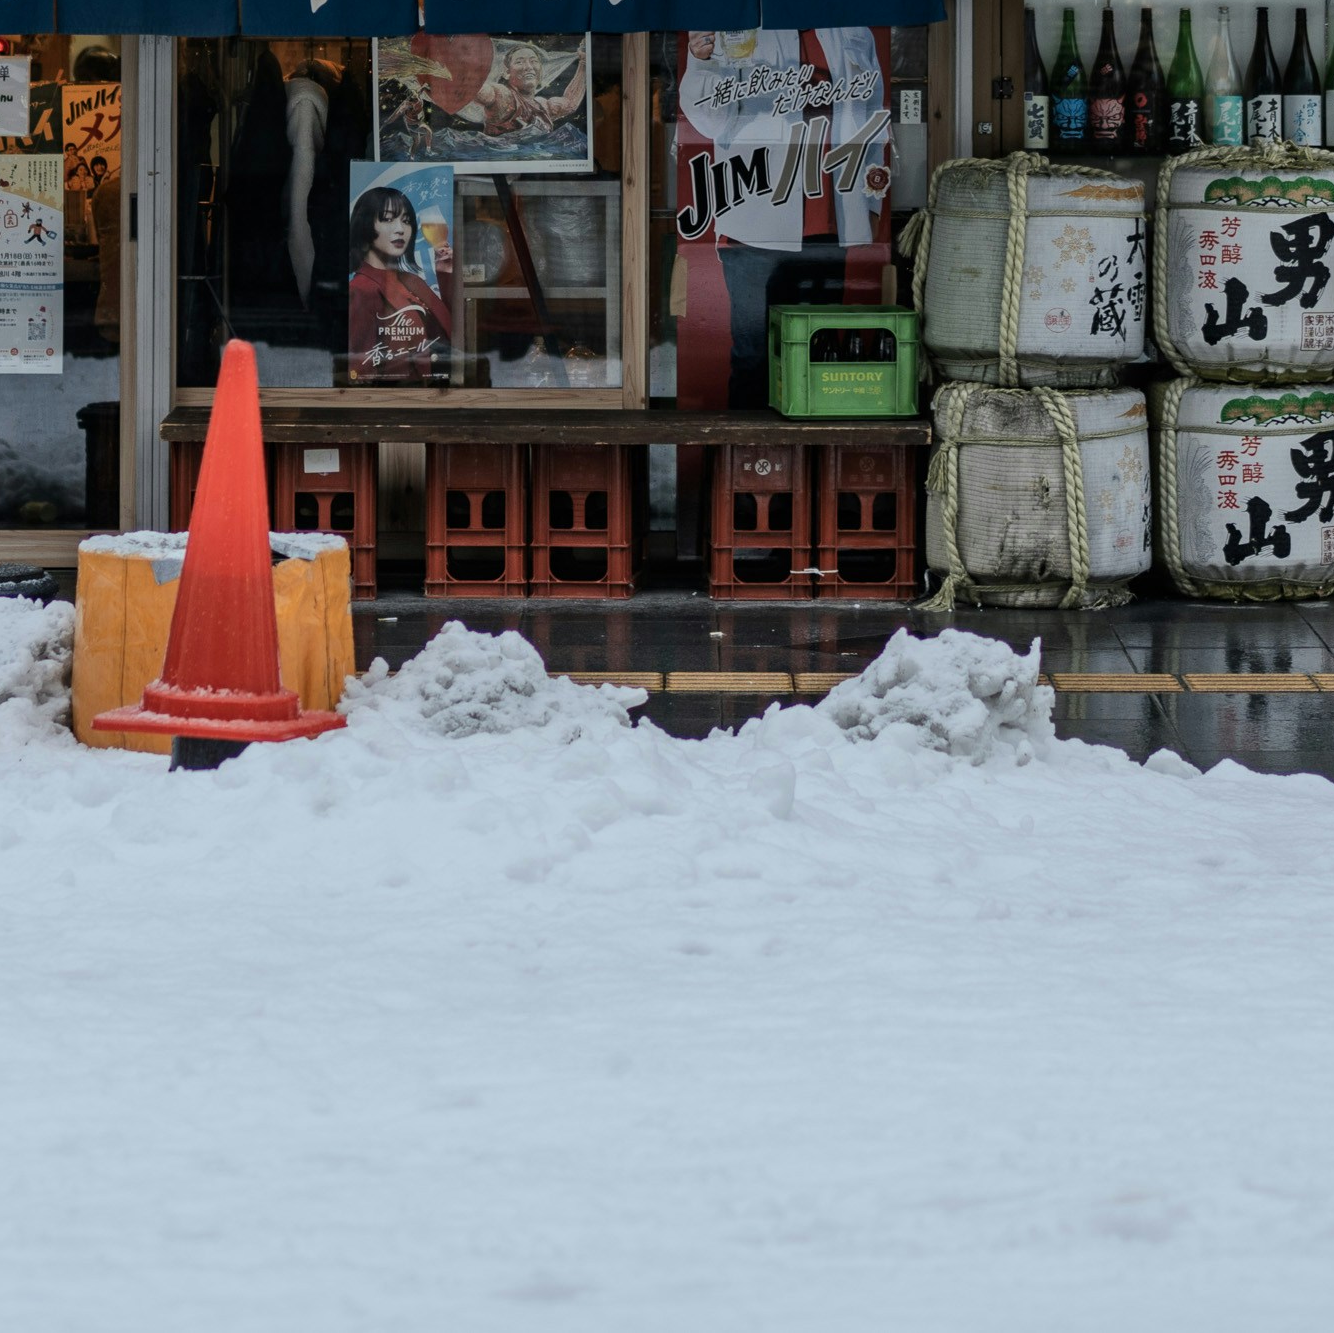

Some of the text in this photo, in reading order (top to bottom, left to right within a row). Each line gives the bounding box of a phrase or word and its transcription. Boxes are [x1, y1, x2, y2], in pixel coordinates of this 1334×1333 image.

[694, 64, 814, 109] 一緒に飲みたい
[771, 72, 879, 117] だけなんだ!
[1198, 230, 1220, 289] 秀四海
[1221, 216, 1243, 264] 芳醇
[362, 337, 440, 367] 香るエール
[378, 327, 424, 336] PREMIUM
[822, 372, 883, 382] SUNTORY
[1216, 449, 1240, 509] 秀四海
[1240, 435, 1265, 484] 芳醇
